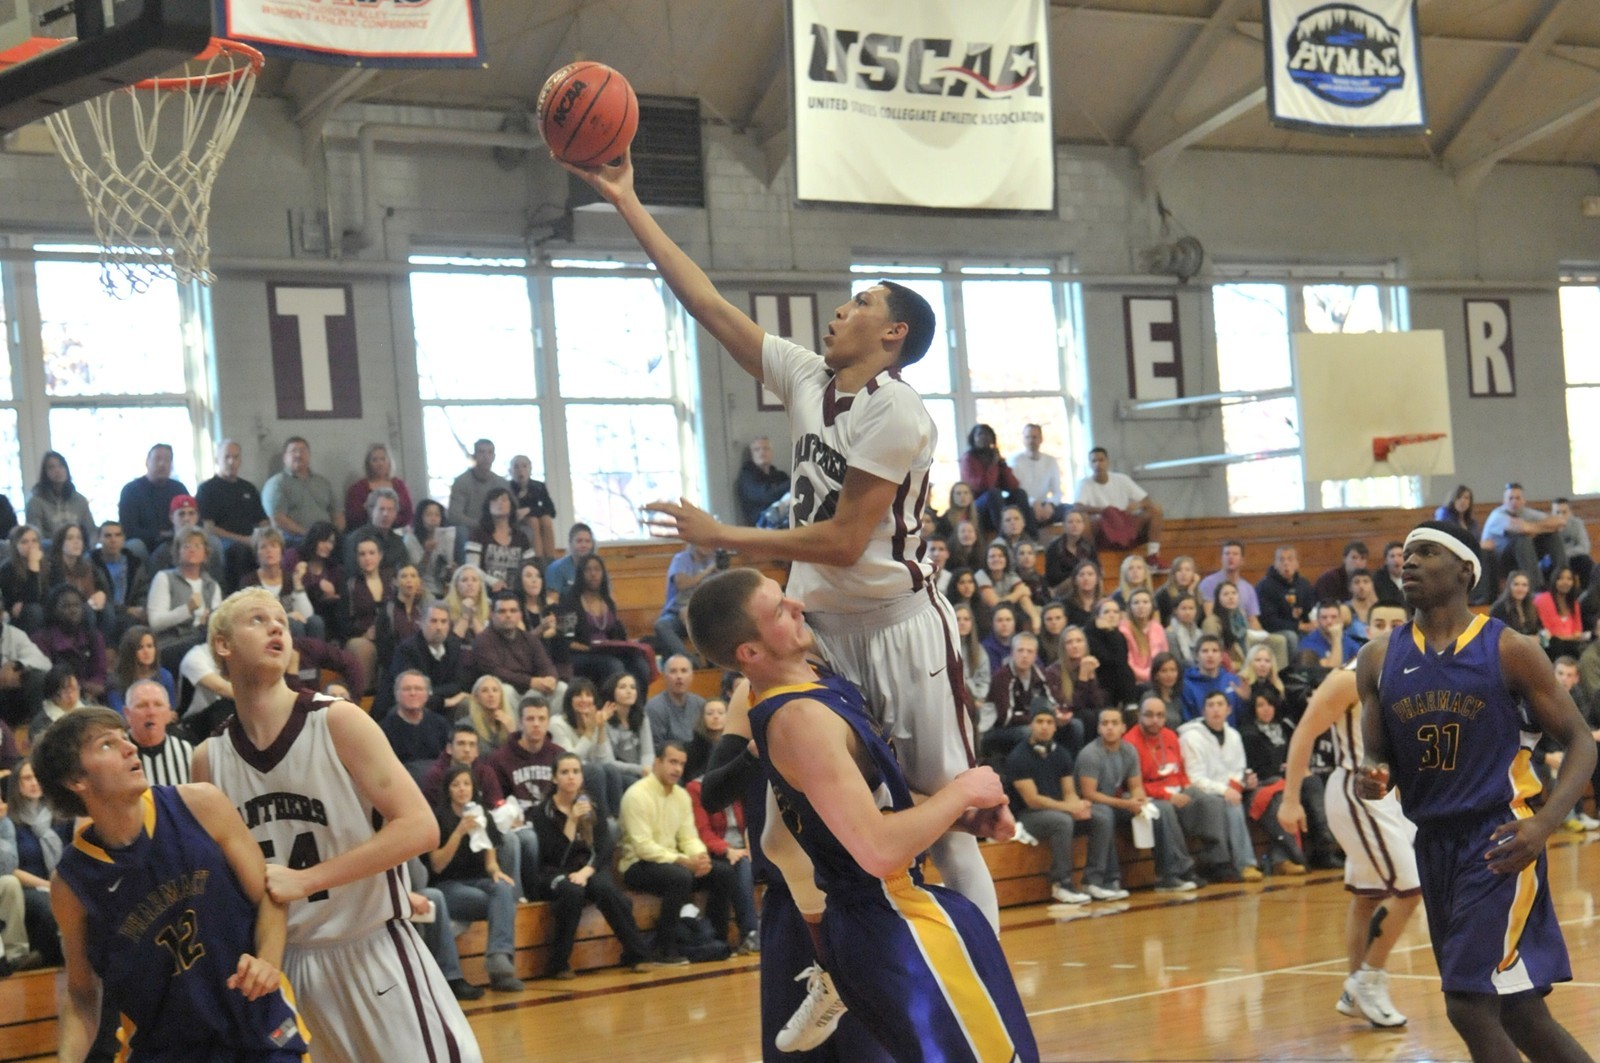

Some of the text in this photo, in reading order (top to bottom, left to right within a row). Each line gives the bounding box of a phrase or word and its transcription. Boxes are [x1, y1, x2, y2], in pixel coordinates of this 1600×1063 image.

[361, 19, 428, 29] CONFERENCE
[808, 97, 848, 111] UNITED
[880, 106, 937, 121] COLLEGIATE
[940, 111, 978, 125] ATHLETIC
[981, 112, 1044, 125] ASSOCIATION
[275, 287, 346, 411] T
[1129, 299, 1178, 400] E
[1467, 302, 1513, 394] R
[1392, 690, 1486, 723] PHARMACY
[1417, 723, 1460, 771] 31
[237, 792, 328, 829] NTHERS
[154, 908, 206, 977] 12
